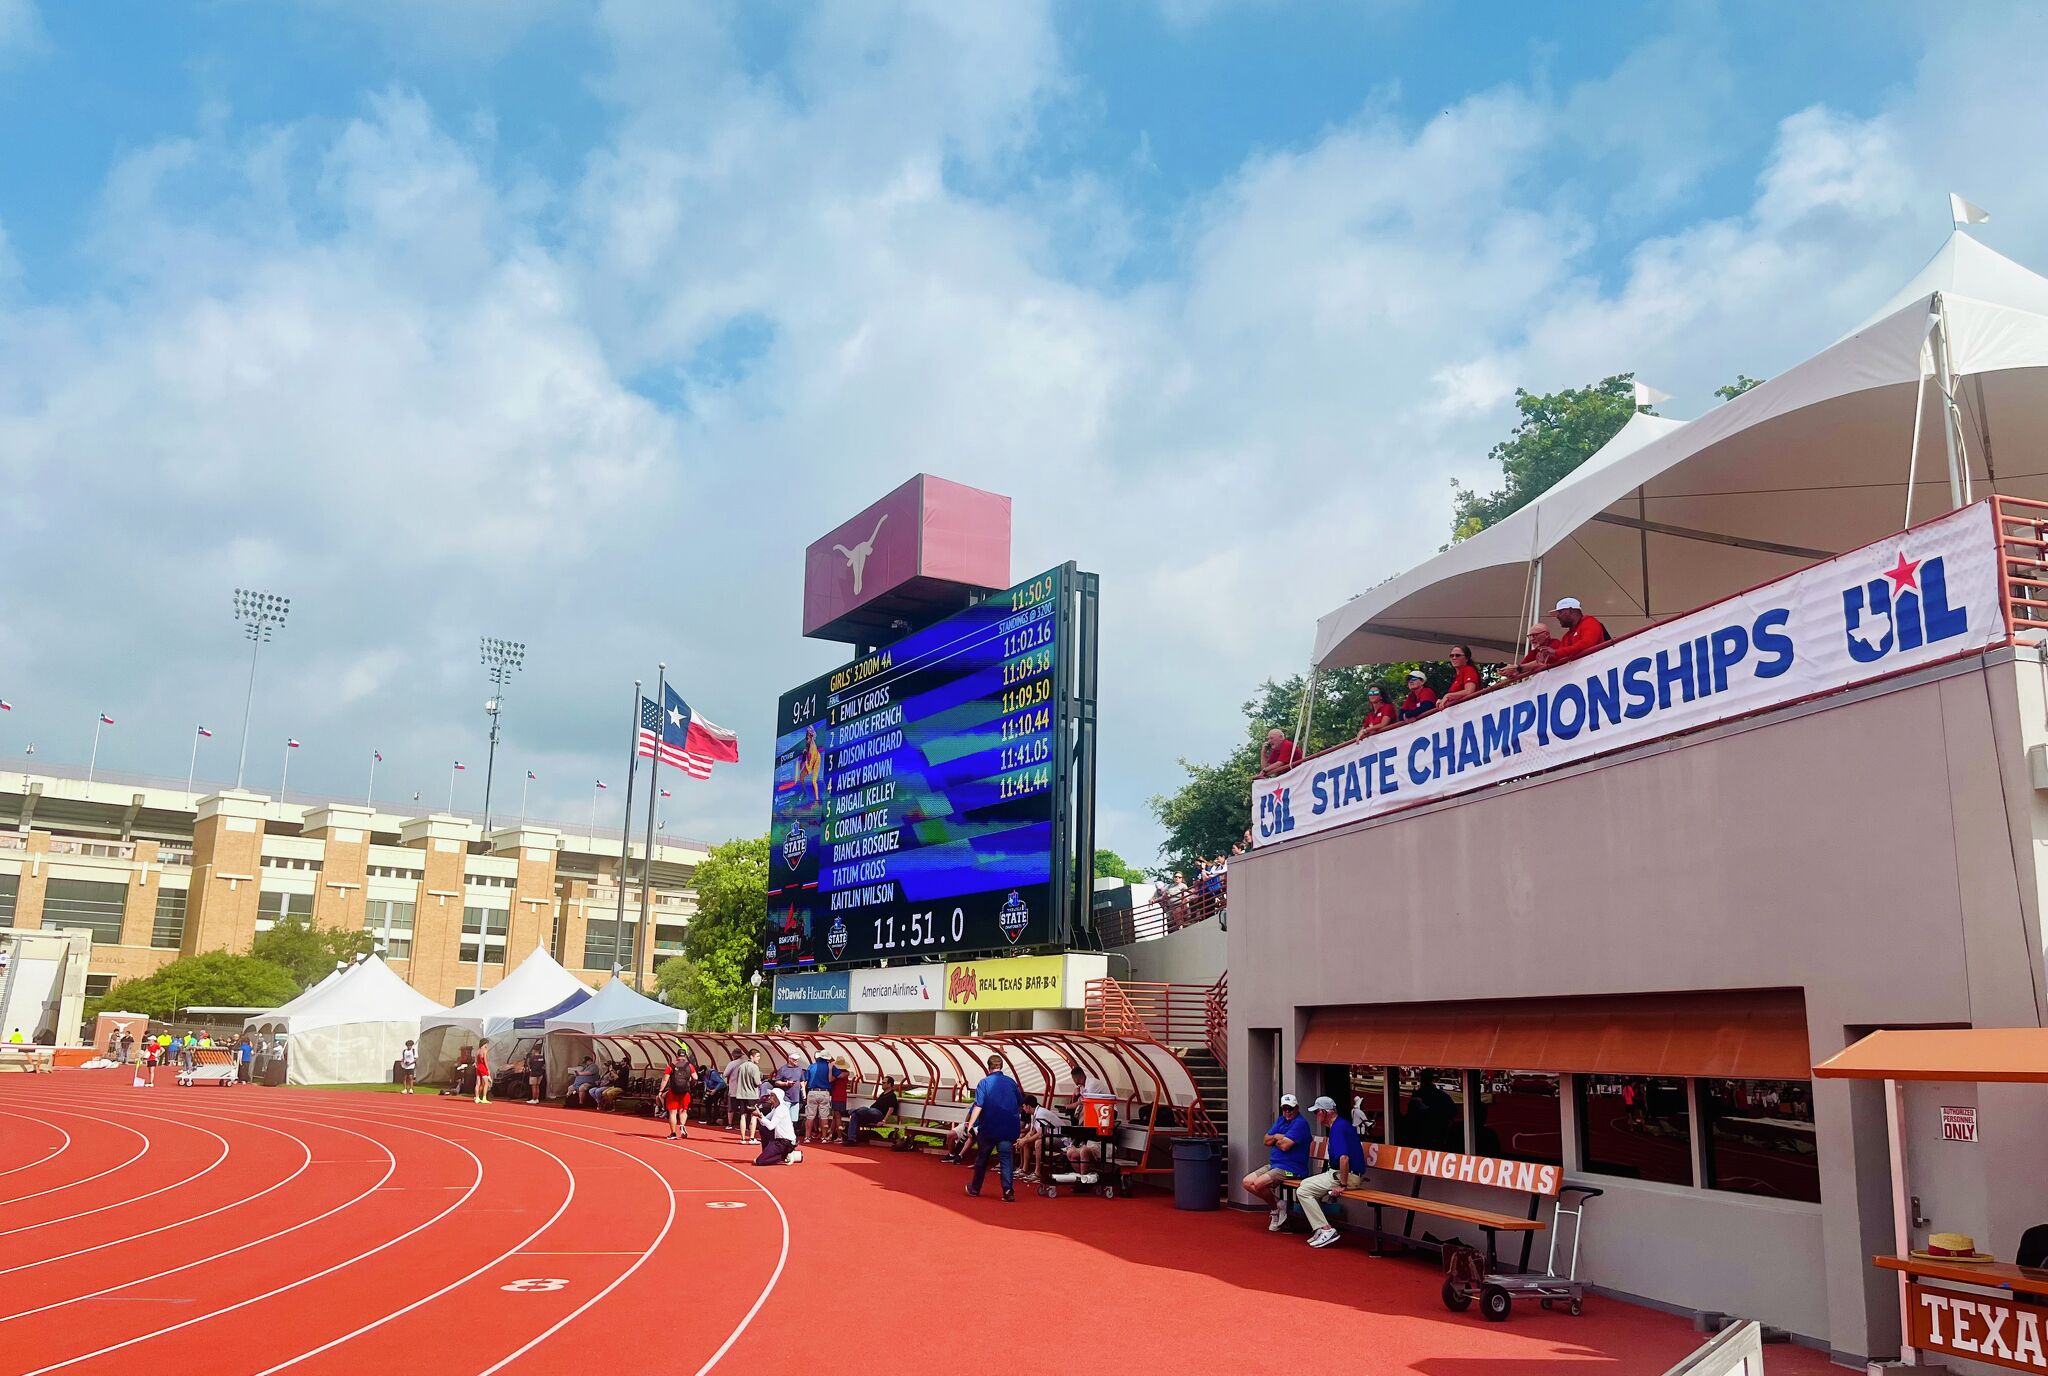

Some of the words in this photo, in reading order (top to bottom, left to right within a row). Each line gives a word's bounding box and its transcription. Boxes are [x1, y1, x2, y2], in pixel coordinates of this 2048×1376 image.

[1011, 575, 1052, 612] 11:50.9
[998, 611, 1029, 634] STANDINGS
[1003, 620, 1051, 658] 11:02.16
[830, 668, 853, 692] GIRLS'
[854, 655, 880, 682] 3200M
[881, 650, 892, 669] 4A
[1003, 649, 1050, 686] 11:09.38
[793, 694, 817, 724] 9:41
[830, 708, 836, 725] 1
[840, 697, 864, 721] EMILY
[864, 686, 890, 712] GROSS
[1002, 678, 1050, 714] 11:09.50
[1260, 784, 1295, 838] UIL
[1311, 747, 1399, 816] STATE
[1407, 608, 1795, 786] CHAMPIONSHIPS
[1842, 553, 1968, 663] UIL
[829, 731, 835, 748] 2
[840, 719, 869, 744] BROOKE
[871, 705, 902, 731] FRENCH
[1001, 708, 1049, 742] 11:10.44
[828, 754, 834, 772] 3
[838, 743, 866, 769] ADISON
[868, 730, 903, 759] RICHARD
[1000, 737, 1048, 771] 11:41.05
[827, 777, 833, 794] 4
[836, 768, 862, 791] AVERY
[862, 758, 893, 784] BROWN
[1000, 767, 1049, 799] 11:41.44
[826, 800, 831, 818] 5
[835, 791, 865, 814] ABIGAIL
[866, 781, 896, 806] KELLEY
[824, 824, 830, 841] 6
[834, 815, 863, 839] CORINA
[863, 808, 889, 833] JOYCE
[784, 839, 806, 854] STATE
[833, 840, 861, 863] BIANCA
[862, 830, 900, 856] BOSQUEZ
[832, 864, 859, 887] TATUM
[860, 858, 886, 881] CROSS
[831, 888, 861, 911] KAITLIN
[862, 882, 894, 906] WILSON
[1000, 911, 1028, 926] STATE
[828, 933, 847, 945] STATE
[861, 984, 892, 998] American
[892, 983, 918, 996] Airlines
[949, 966, 977, 1005] Rudy's
[979, 977, 998, 991] REAL
[998, 977, 1023, 991] TEXAS
[1025, 975, 1057, 990] BAR-B-Q
[1100, 1105, 1110, 1117] G
[1943, 1108, 1974, 1116] AUTHORIZED
[1943, 1115, 1975, 1124] PERSONNEL
[1944, 1123, 1975, 1140] ONLY
[1393, 1146, 1556, 1194] LONGHORNS
[1920, 1292, 2048, 1368] TEXA
